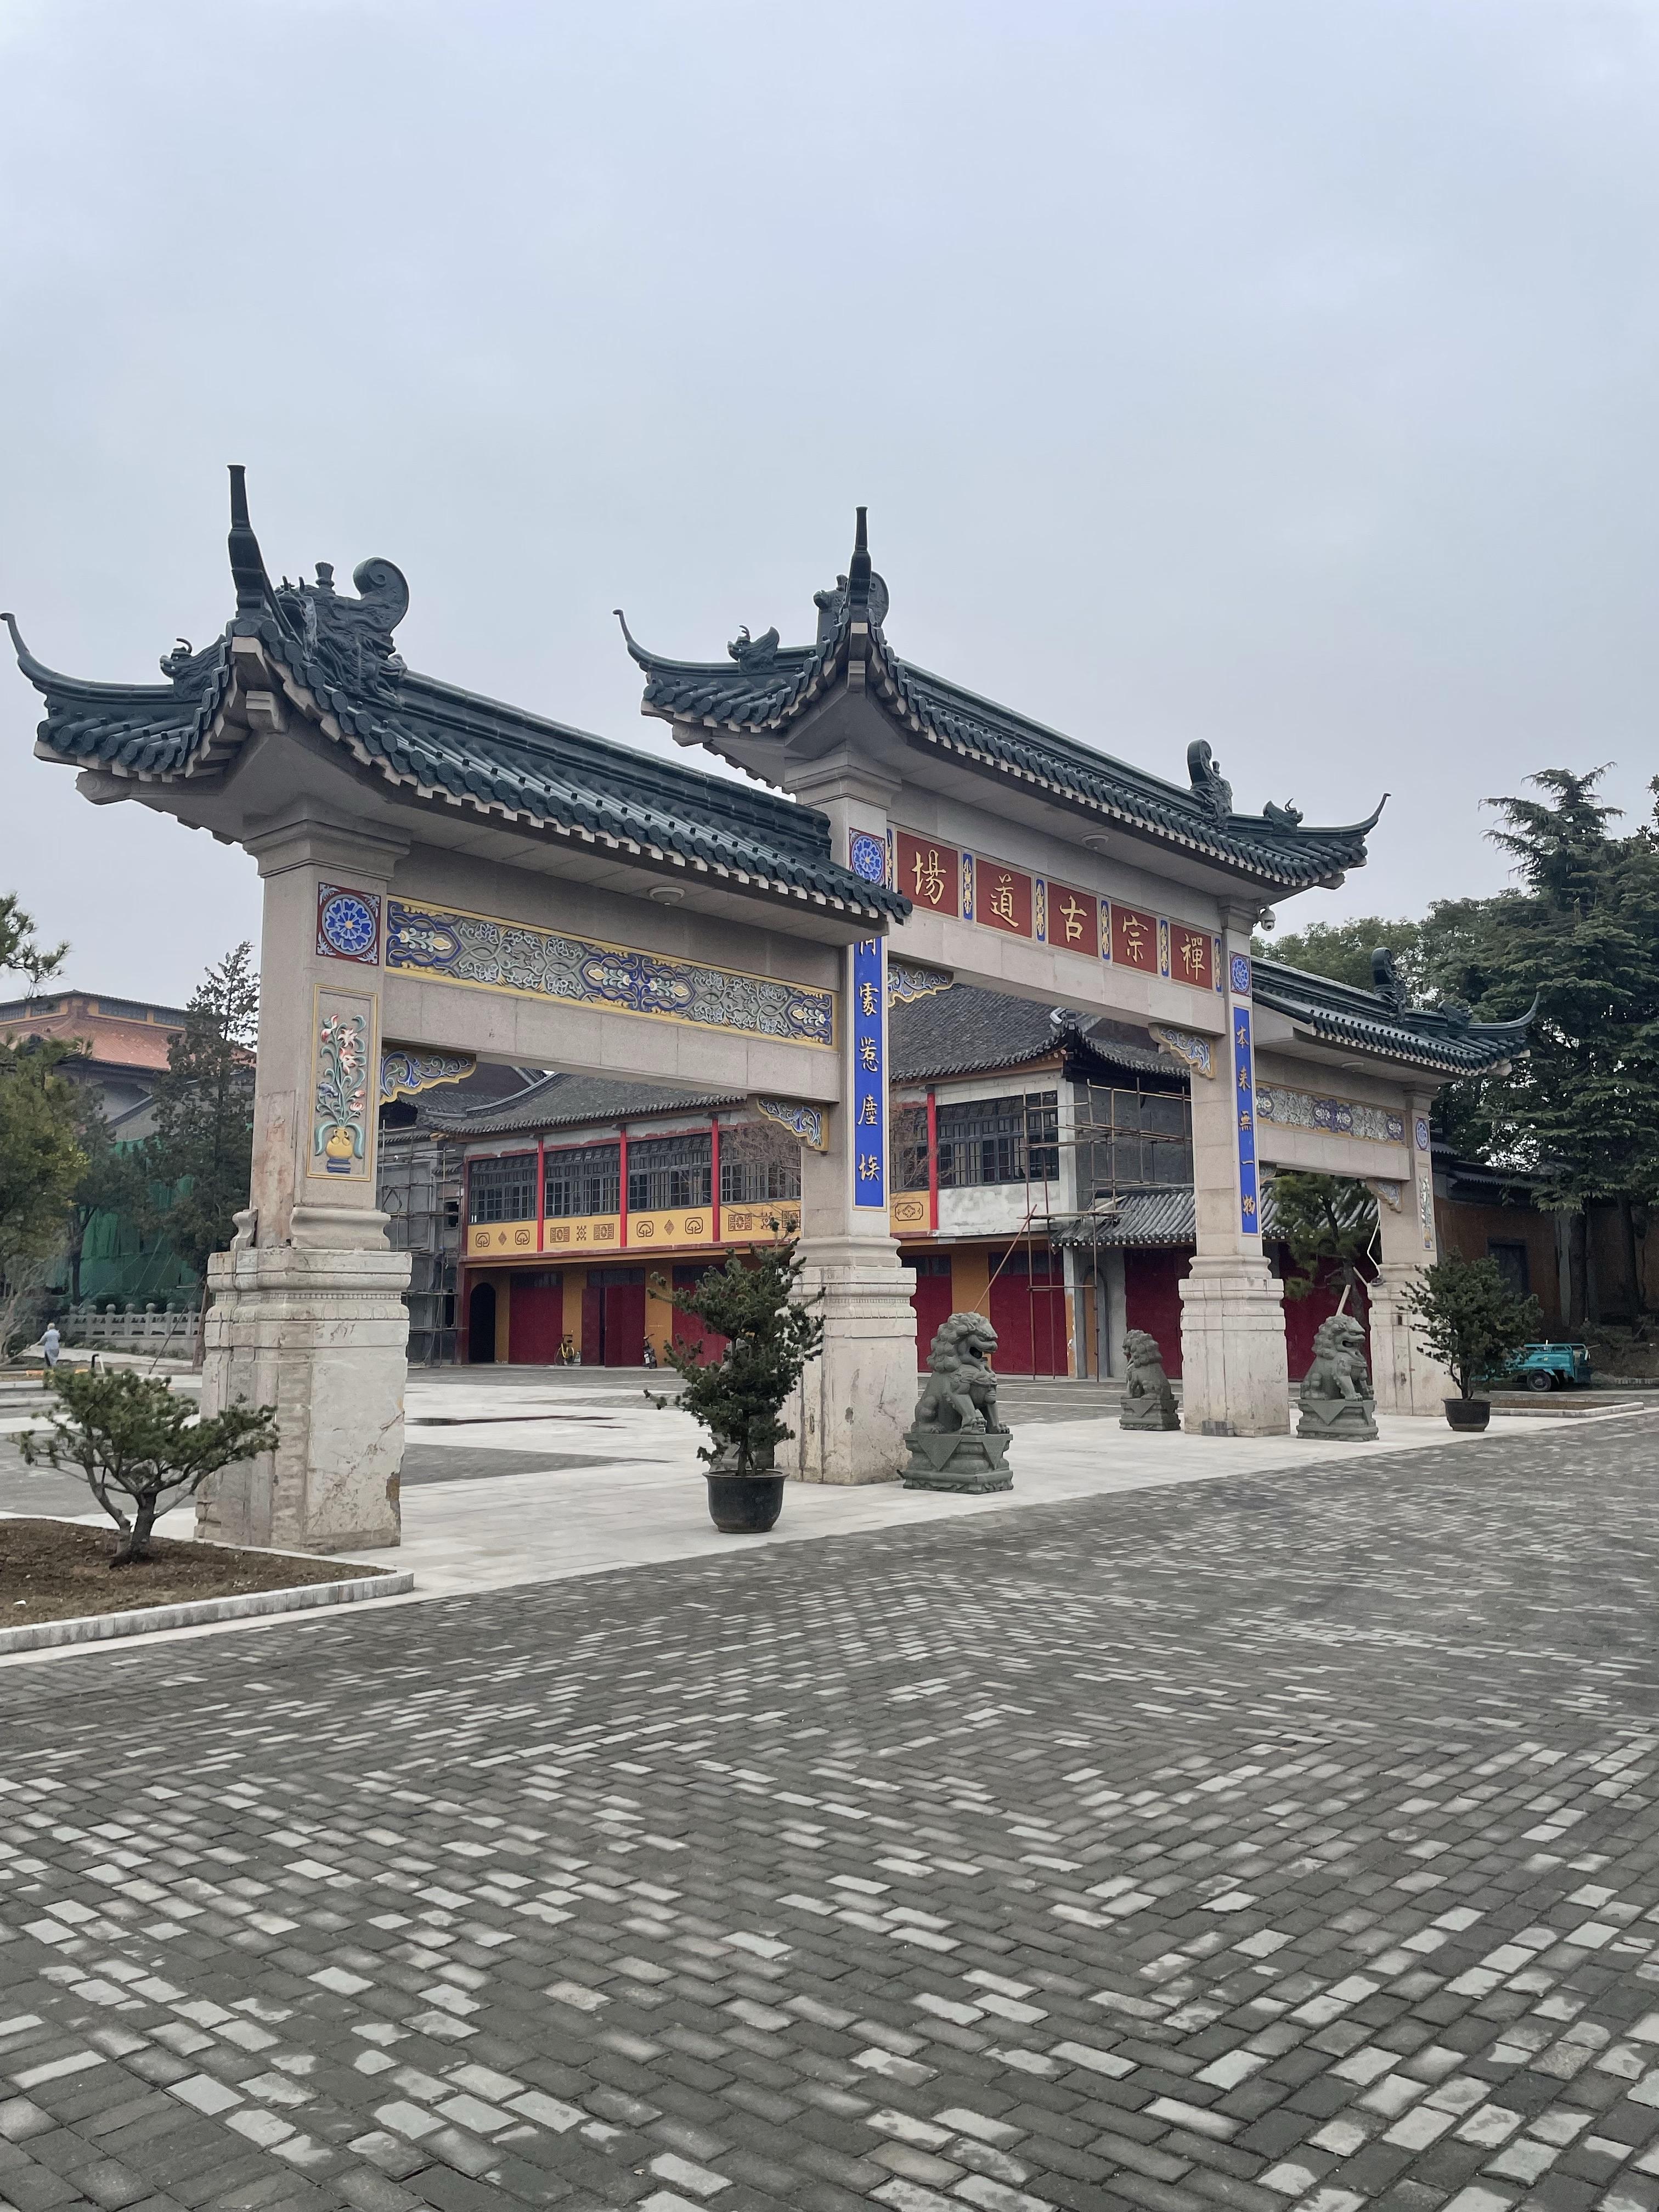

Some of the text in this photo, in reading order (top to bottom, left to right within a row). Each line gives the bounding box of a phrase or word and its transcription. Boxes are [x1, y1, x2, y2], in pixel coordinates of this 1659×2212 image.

[1237, 1025, 1255, 1216] 本來無一物
